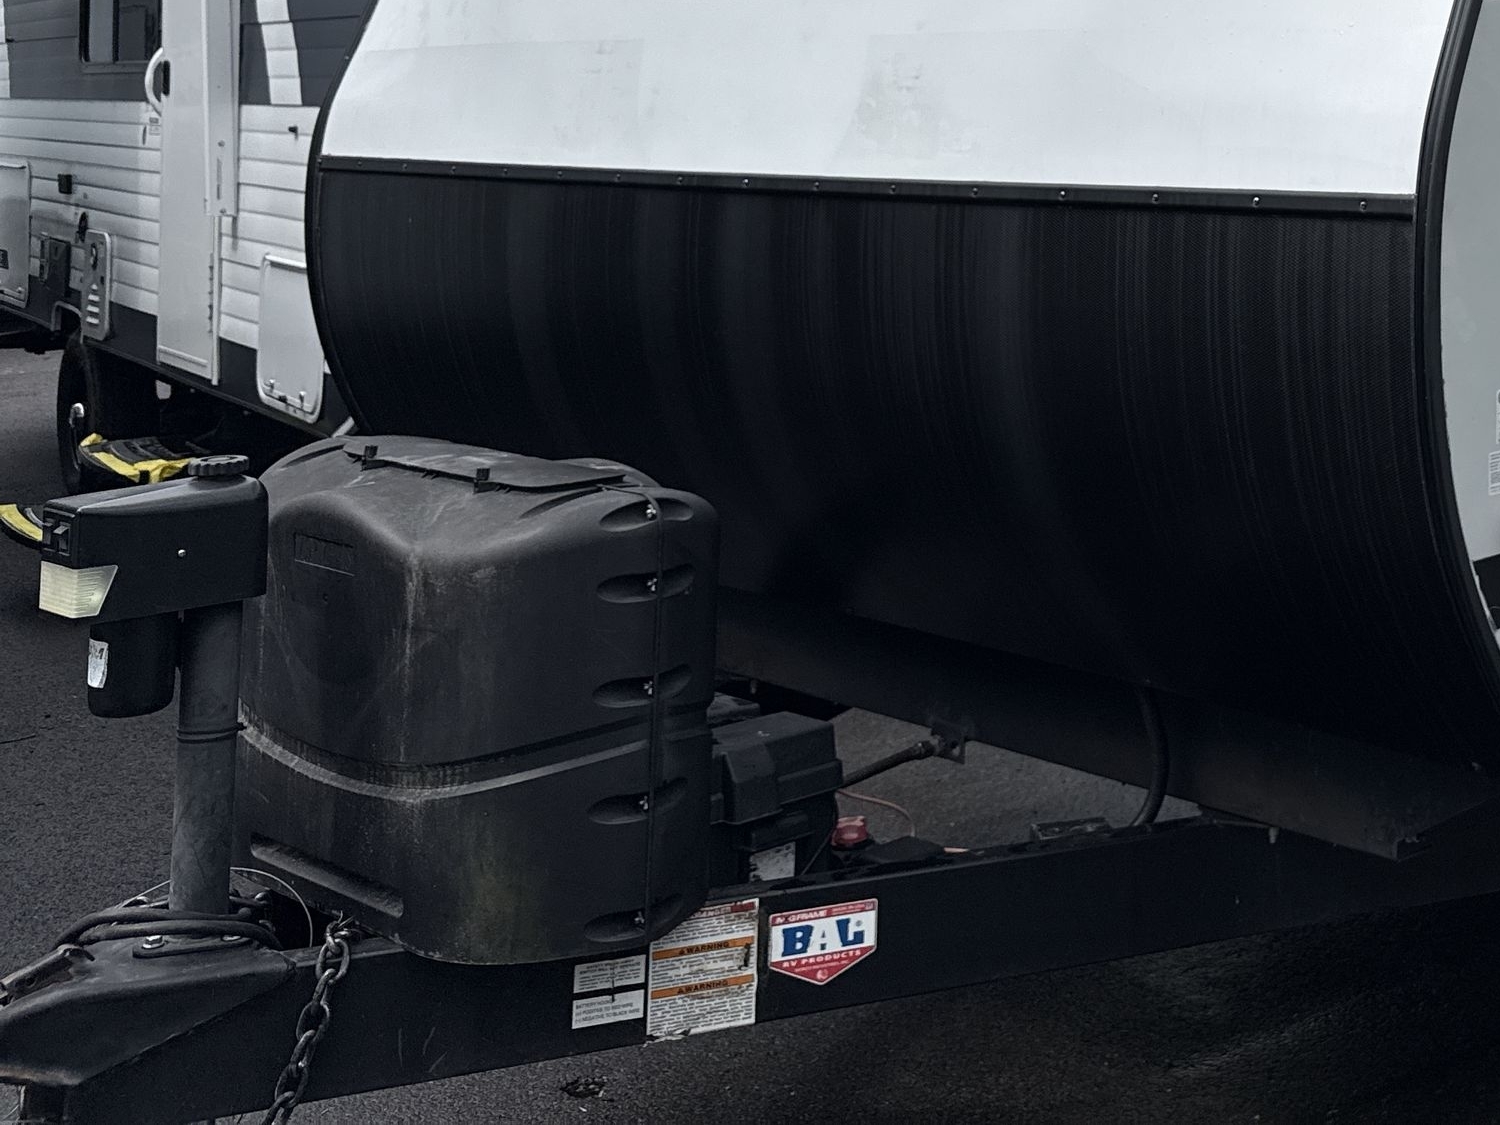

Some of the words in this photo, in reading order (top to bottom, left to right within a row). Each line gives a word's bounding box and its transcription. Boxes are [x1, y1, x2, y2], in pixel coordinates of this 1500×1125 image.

[782, 915, 864, 957] BAL
[686, 941, 730, 954] WARNING
[783, 960, 797, 968] RV
[801, 950, 861, 965] PRODUCTS
[685, 980, 729, 993] WARNING
